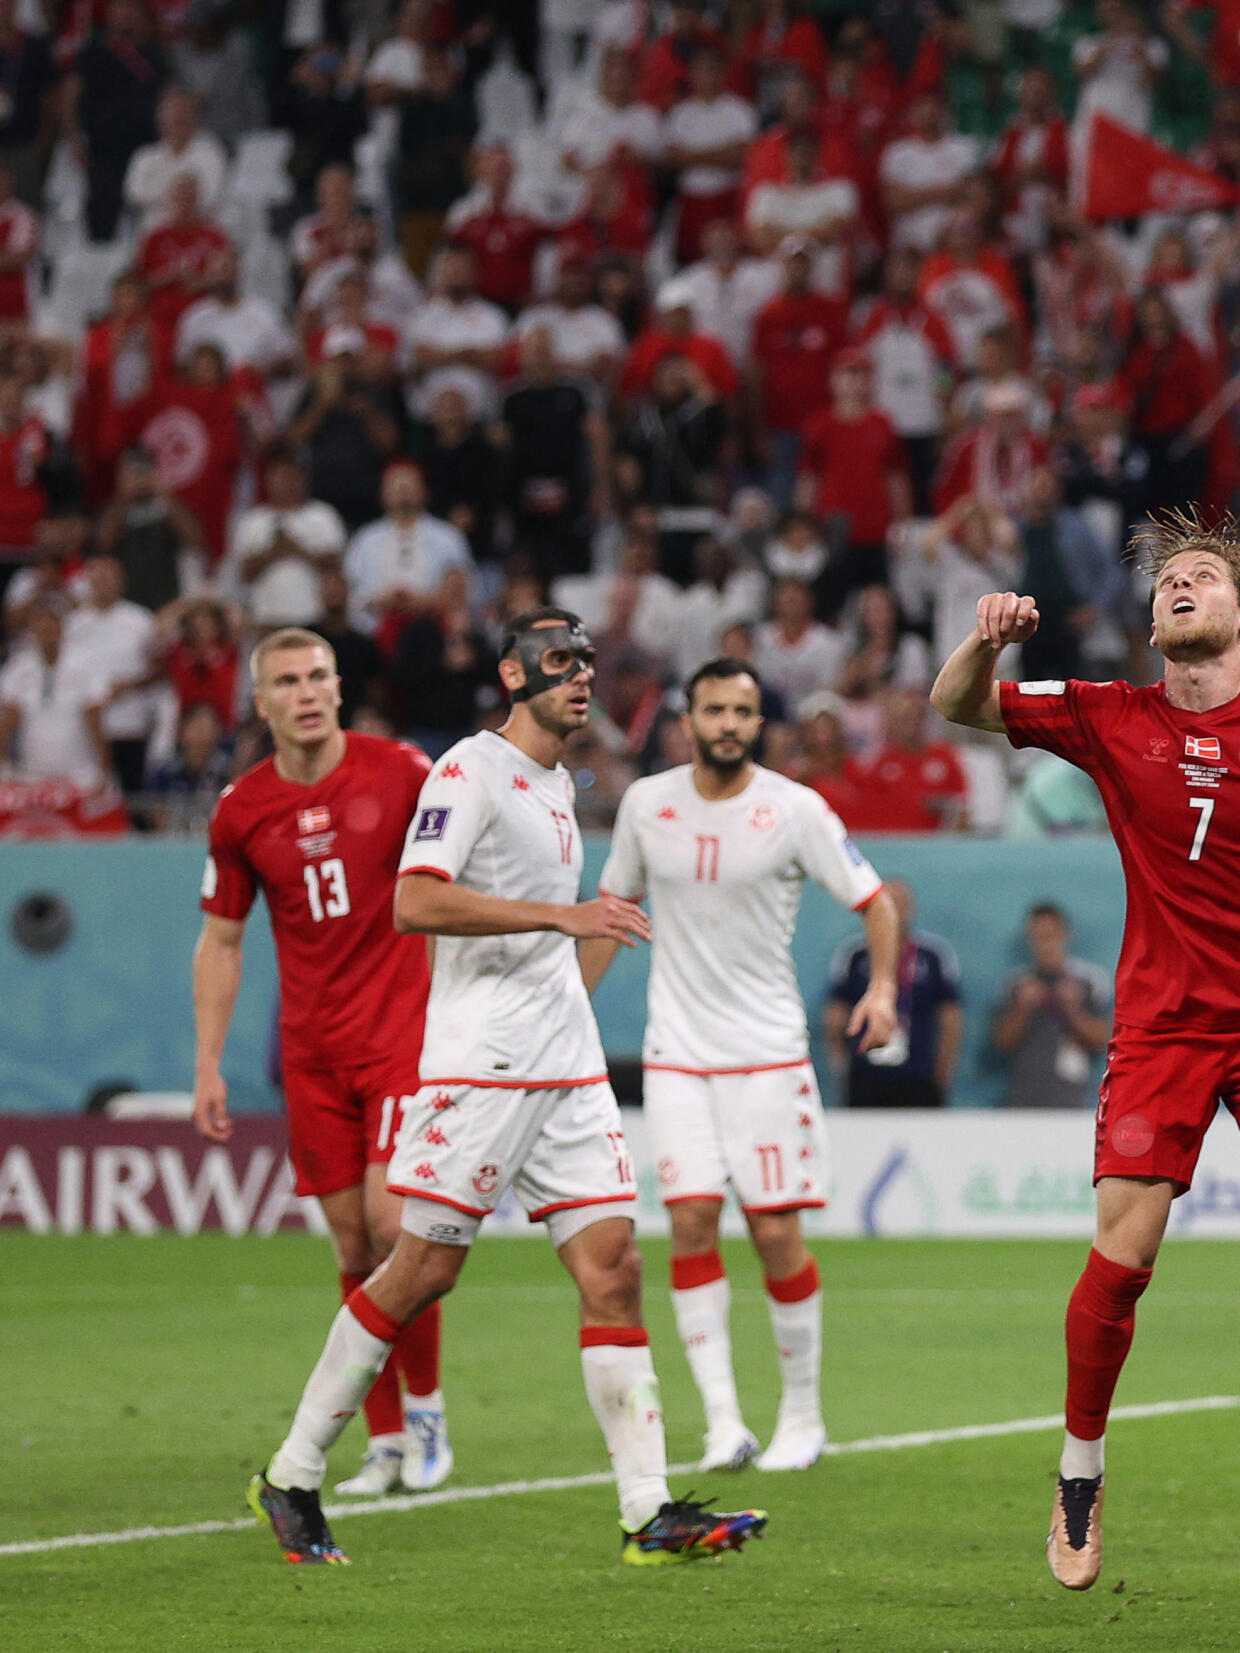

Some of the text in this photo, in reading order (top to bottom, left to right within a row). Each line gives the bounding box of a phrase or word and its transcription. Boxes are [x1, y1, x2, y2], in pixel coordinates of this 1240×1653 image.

[696, 825, 719, 883] 11
[1189, 797, 1214, 860] 7
[303, 857, 351, 922] 13
[756, 1145, 784, 1192] 11
